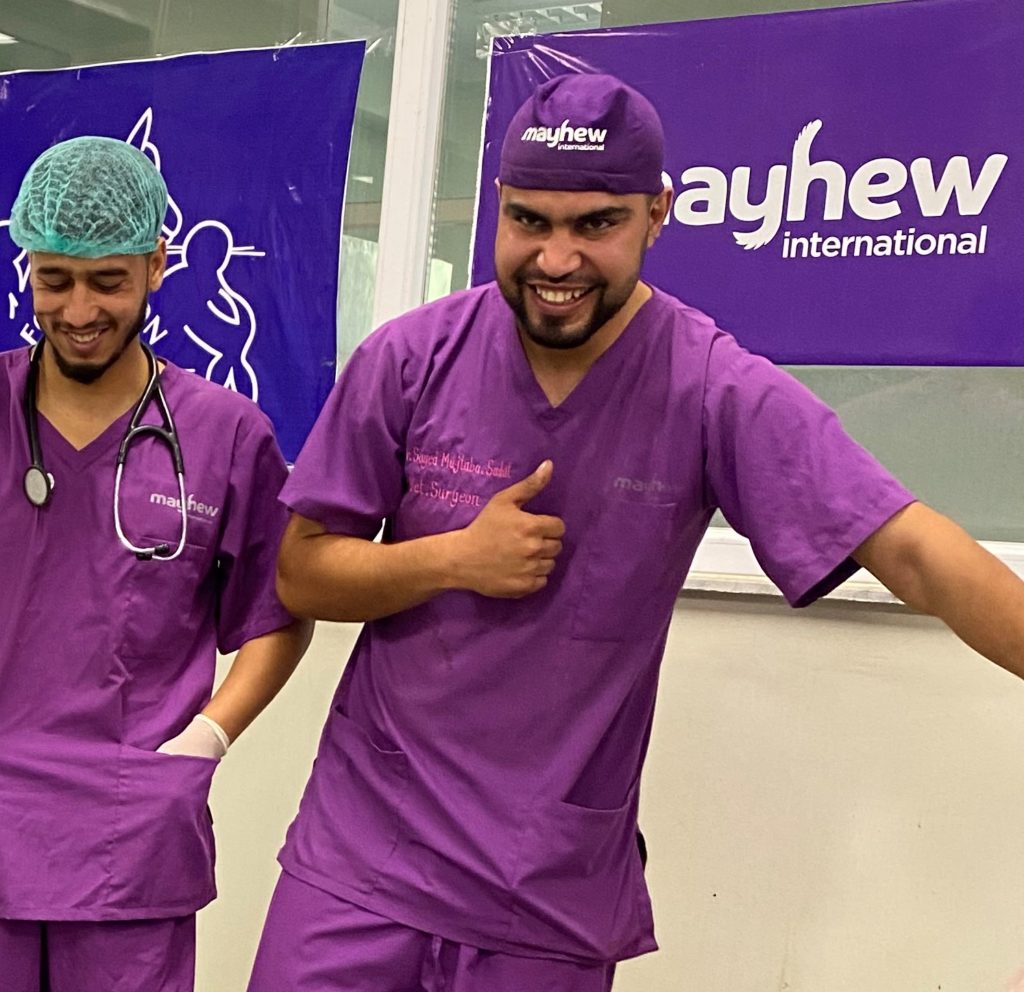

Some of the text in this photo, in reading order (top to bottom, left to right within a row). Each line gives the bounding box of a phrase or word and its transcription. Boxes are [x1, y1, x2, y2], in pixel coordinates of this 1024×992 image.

[521, 119, 608, 148] mayhew
[557, 143, 605, 151] international
[661, 119, 1008, 250] ayhew
[782, 225, 988, 259] international
